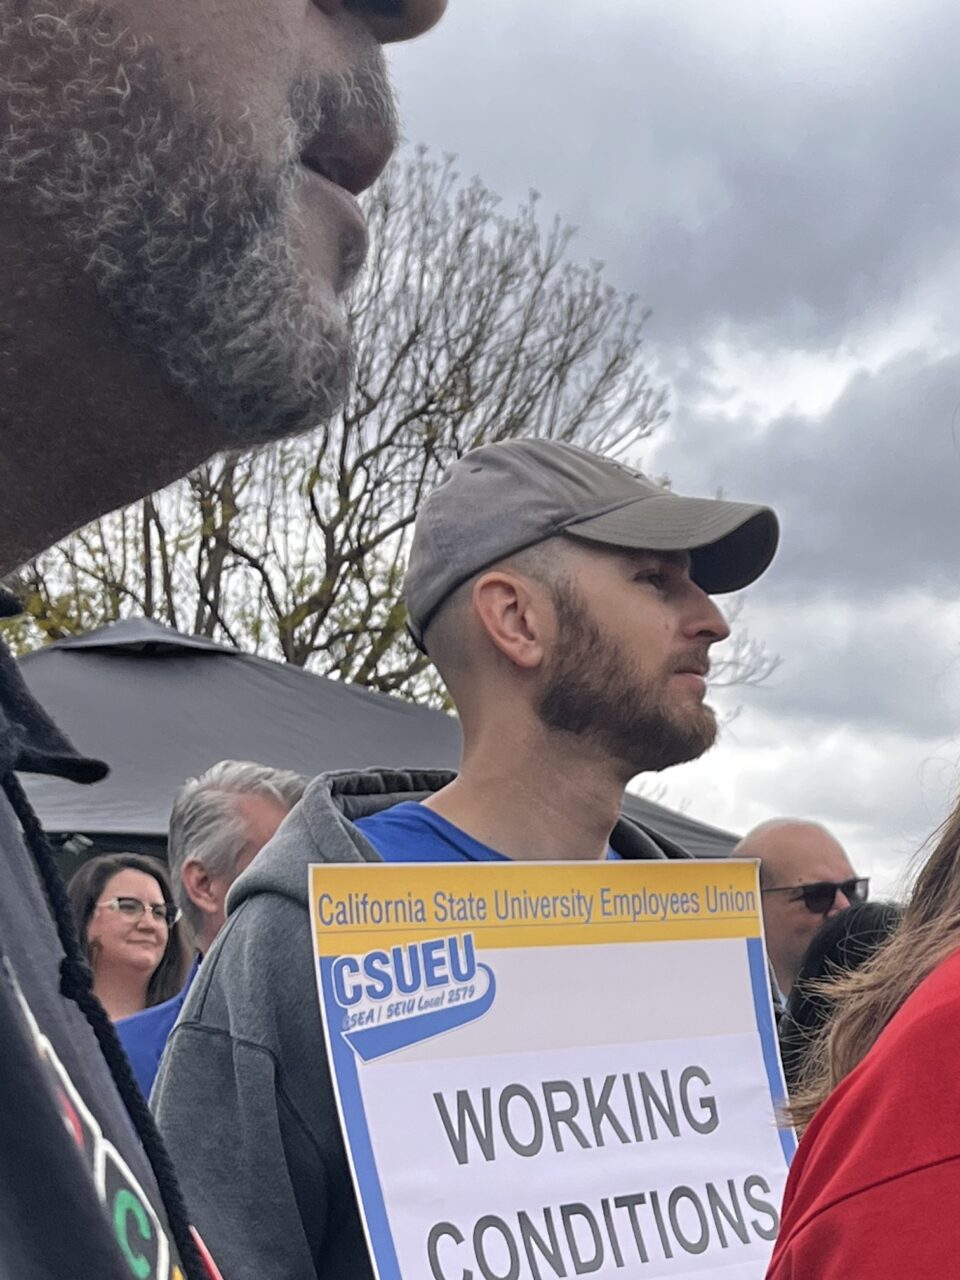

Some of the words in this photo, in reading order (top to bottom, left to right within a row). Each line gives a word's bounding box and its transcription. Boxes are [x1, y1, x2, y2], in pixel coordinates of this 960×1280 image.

[318, 892, 427, 927] California
[434, 890, 488, 923] State
[494, 888, 595, 925] University
[600, 886, 700, 923] Employees
[705, 884, 757, 913] Union
[332, 933, 477, 1006] CSUEU
[386, 999, 416, 1019] SEIU
[418, 991, 444, 1011] Local
[447, 984, 476, 1003] 2579
[432, 1064, 721, 1166] WORKING
